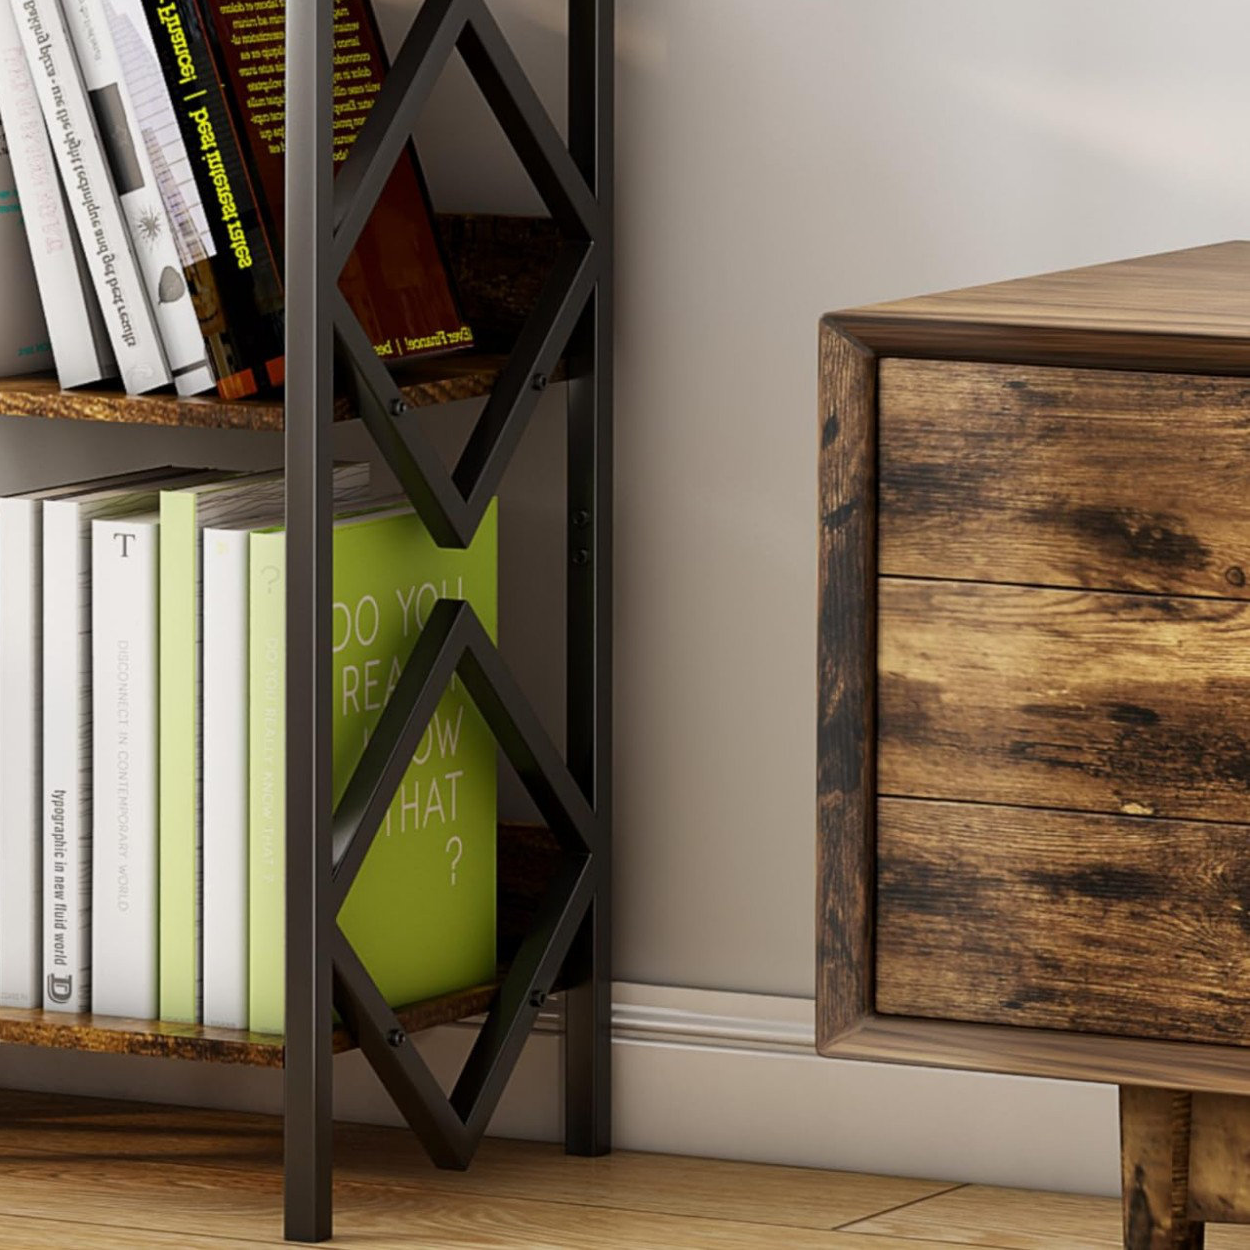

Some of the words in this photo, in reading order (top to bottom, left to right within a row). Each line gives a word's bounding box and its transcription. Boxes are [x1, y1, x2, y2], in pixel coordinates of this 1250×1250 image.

[113, 533, 135, 558] T
[117, 639, 130, 727] DISCONNECT
[119, 731, 129, 746] IN
[117, 750, 130, 860] CONTEMPORARY
[51, 789, 66, 858] typographic
[54, 861, 67, 872] in
[446, 835, 463, 886] ?
[54, 875, 64, 901] new
[117, 865, 130, 913] WORLD
[54, 903, 67, 930] fluid
[54, 933, 67, 966] world
